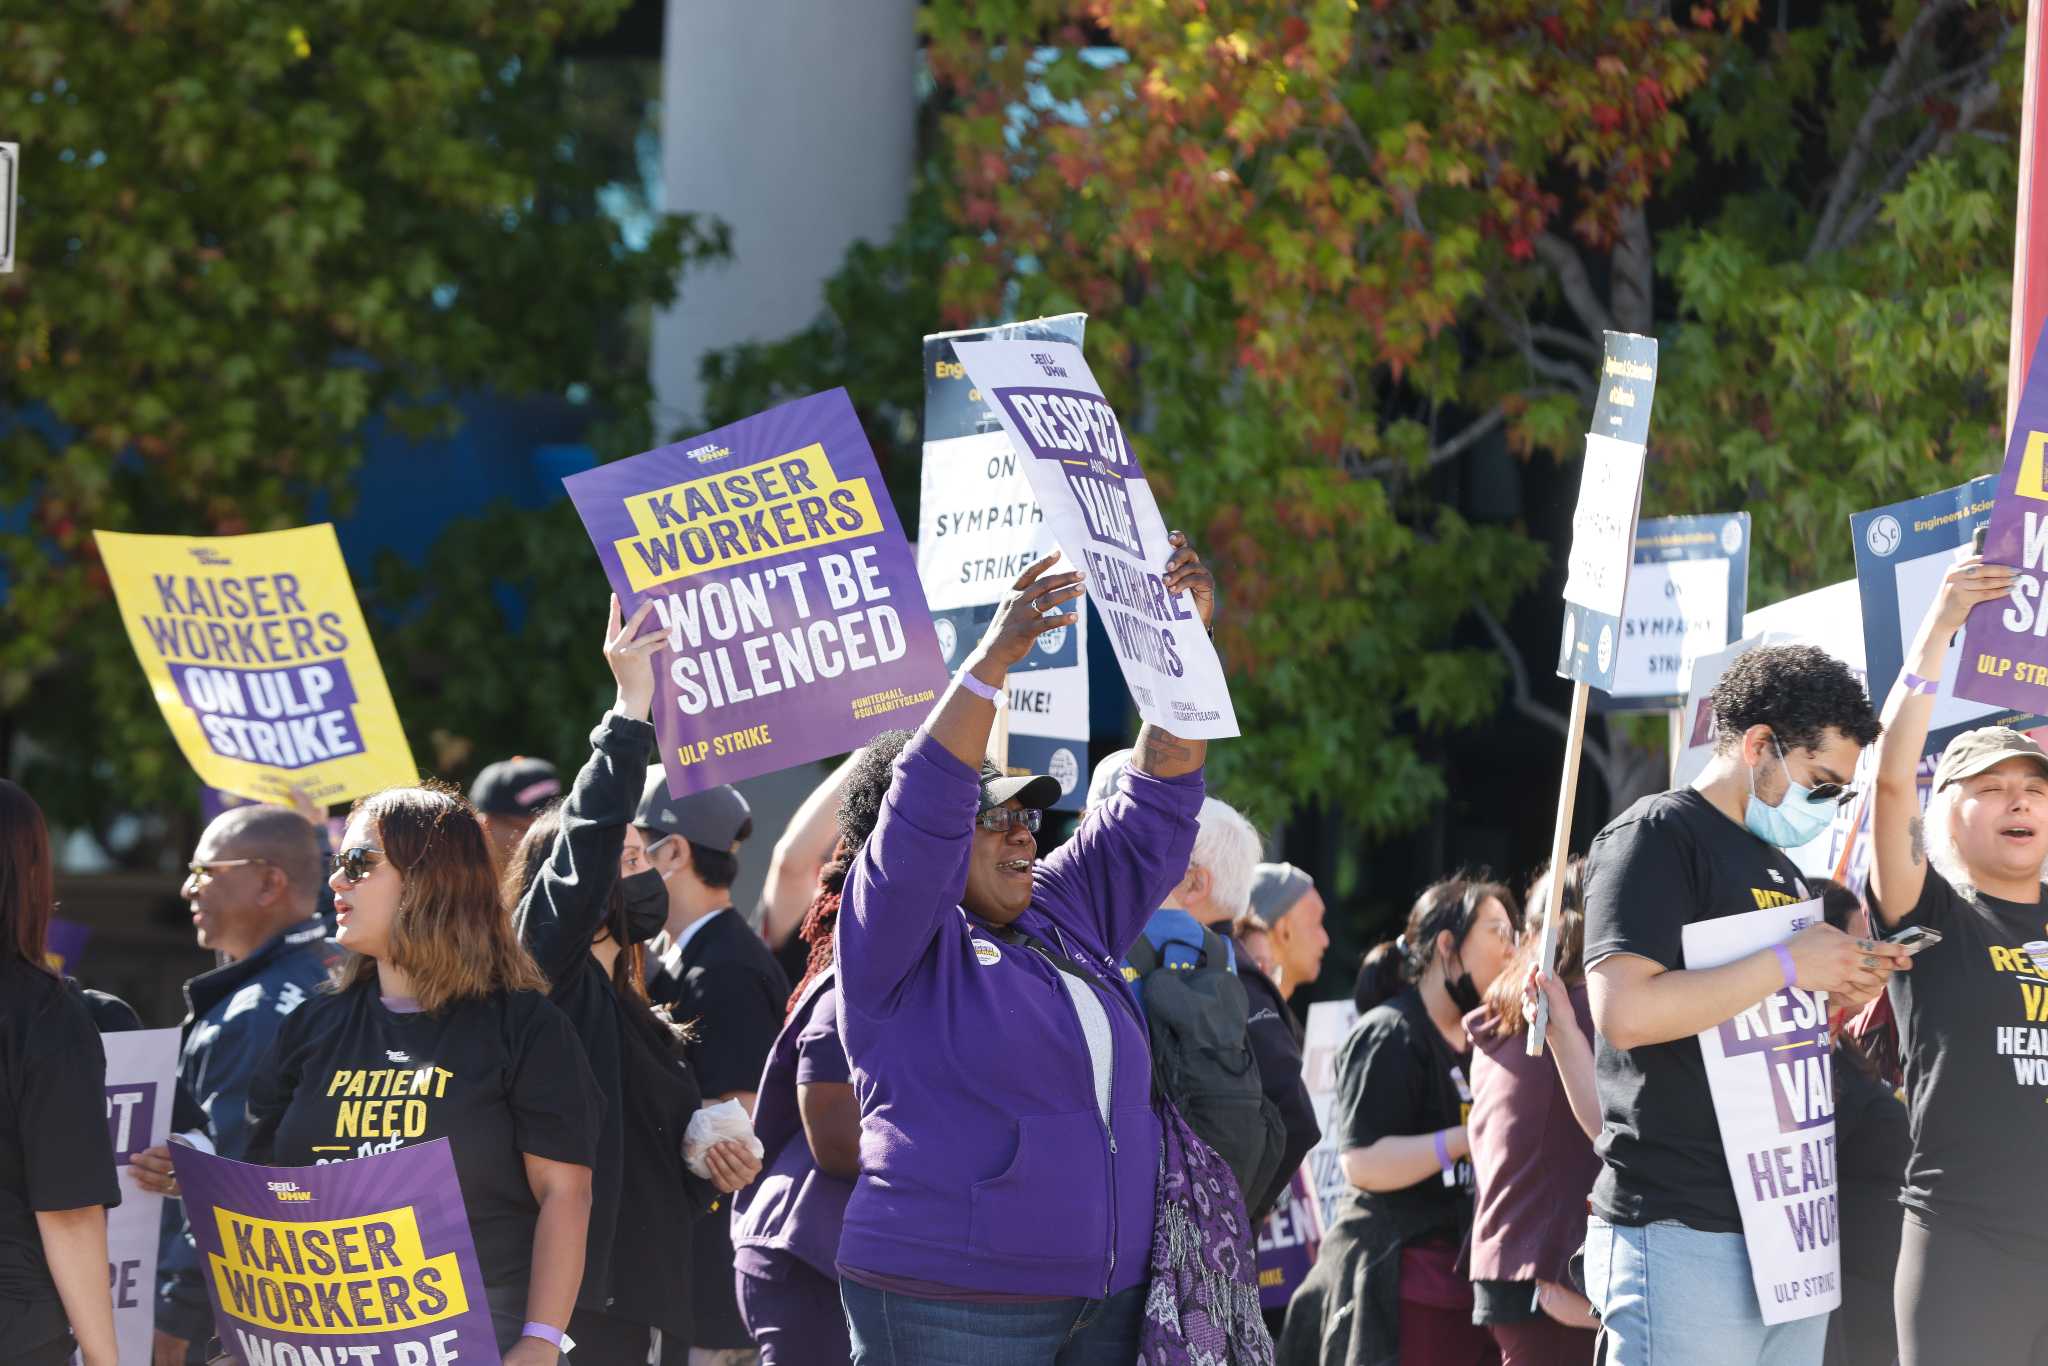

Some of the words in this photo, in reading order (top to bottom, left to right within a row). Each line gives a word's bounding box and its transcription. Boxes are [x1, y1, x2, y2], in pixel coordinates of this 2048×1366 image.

[1009, 394, 1128, 465] RESPECT
[648, 458, 818, 529] KAISER
[987, 454, 1016, 479] ON
[633, 488, 864, 577] WORKERS
[1070, 475, 1139, 552] VALUE
[153, 572, 307, 620] KAISER
[818, 546, 890, 610] BE
[141, 612, 349, 664] WORKERS
[671, 604, 907, 715] SILENCED
[1977, 654, 2011, 676] ULP
[183, 666, 246, 718] ON
[246, 665, 334, 720] ULP
[200, 710, 357, 769] STRIKE
[678, 740, 709, 767] ULP
[714, 724, 772, 757] STRIKE
[326, 1066, 454, 1098] PATIENT
[335, 1099, 427, 1138] NEED
[277, 1191, 311, 1201] UHW
[232, 1220, 402, 1275] KAISER
[222, 1267, 448, 1328] WORKERS
[1774, 1281, 1800, 1303] ULP
